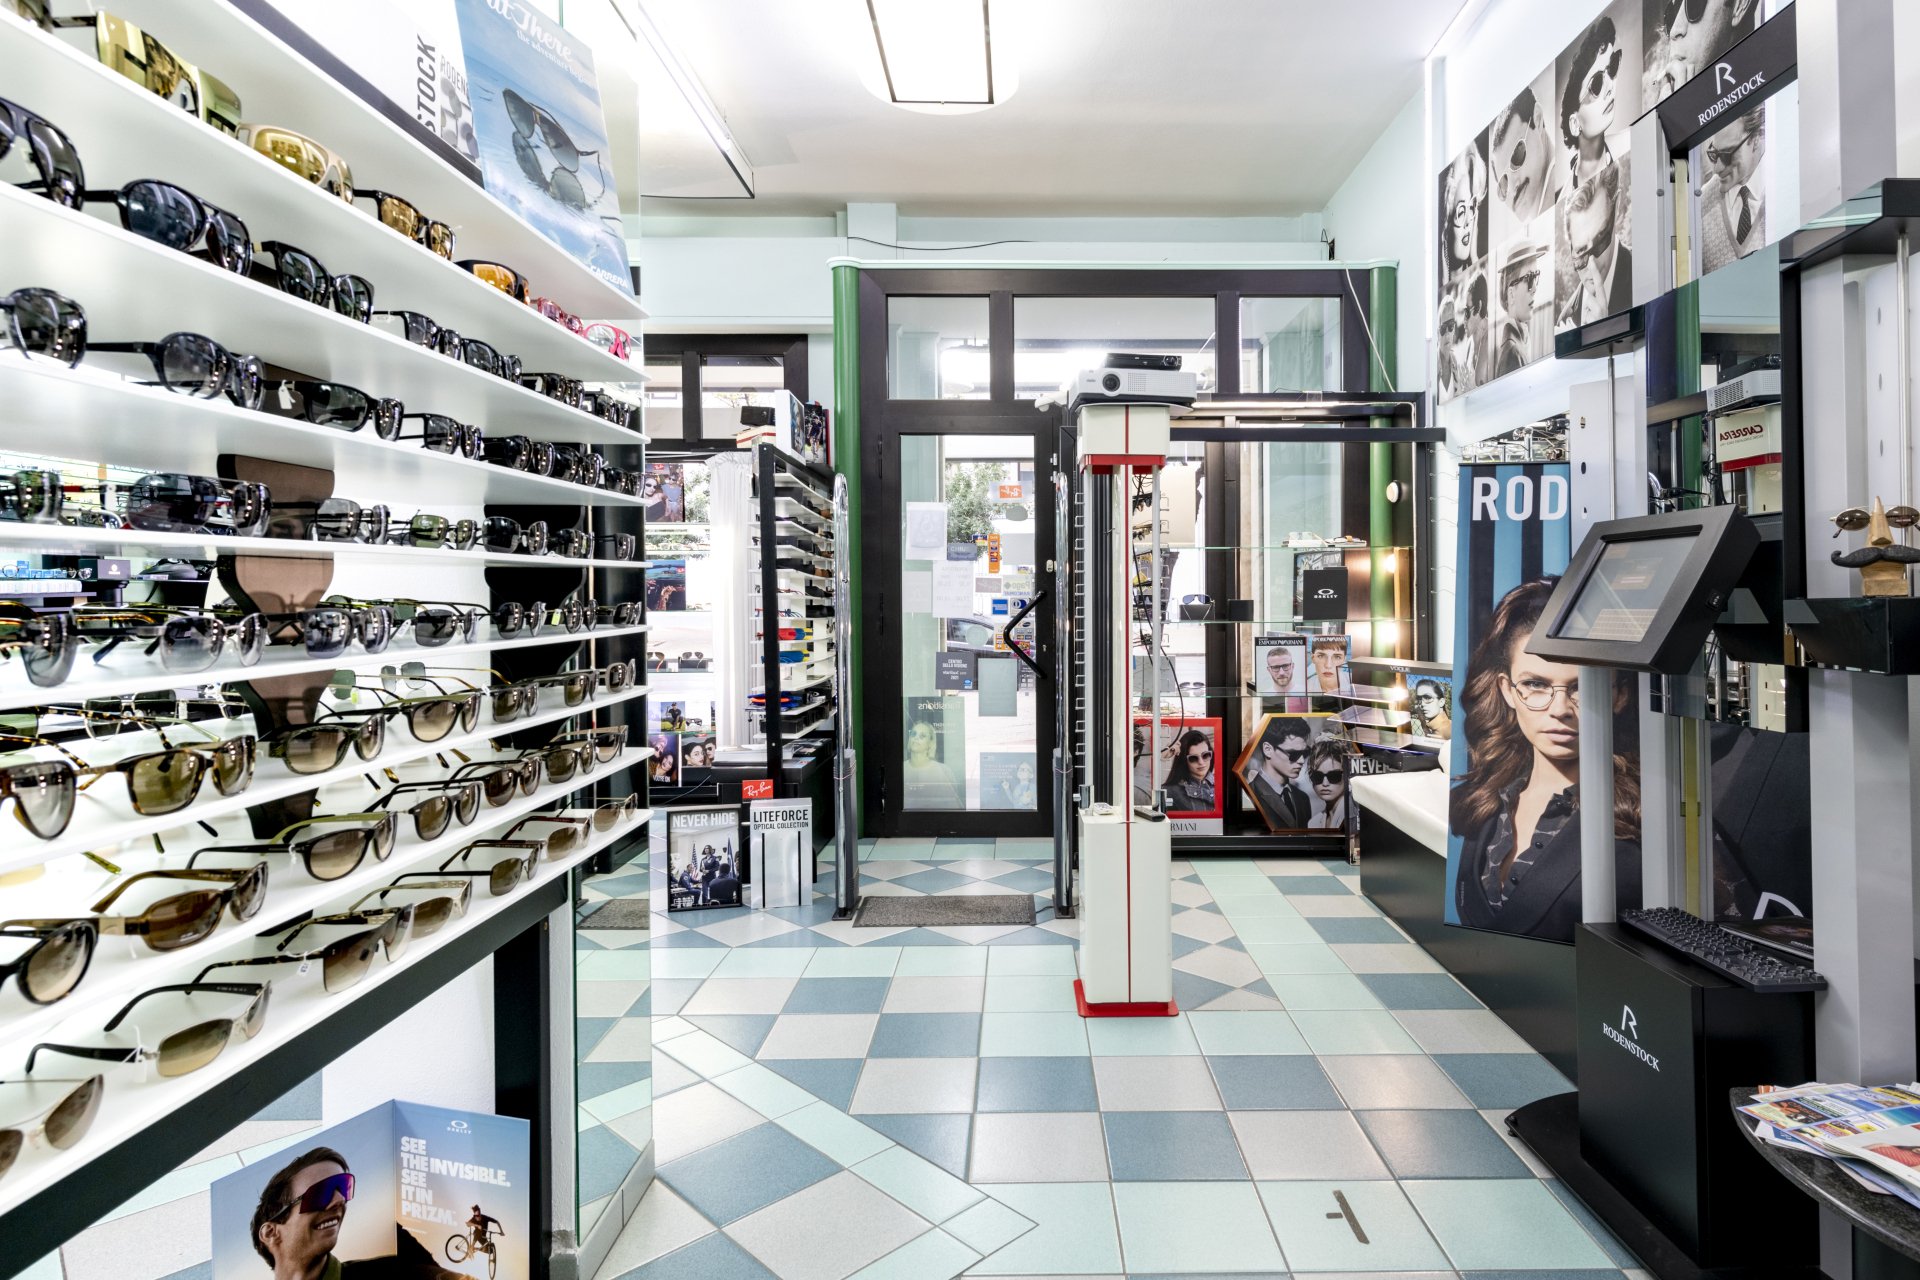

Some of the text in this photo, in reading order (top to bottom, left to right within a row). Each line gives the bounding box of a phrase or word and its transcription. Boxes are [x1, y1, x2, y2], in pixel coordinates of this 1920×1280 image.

[511, 3, 573, 63] There
[516, 30, 530, 45] the
[1697, 71, 1766, 126] RODENSTOCK
[590, 265, 628, 289] CARRERA
[1472, 475, 1568, 522] ROD
[672, 812, 736, 828] NEVER HIDE
[753, 809, 809, 823] LITEFORCE
[753, 821, 809, 830] OPTICAL COLLECTION
[1602, 1022, 1660, 1072] RODENSTOCK
[447, 1126, 472, 1135] OAKLEY
[400, 1136, 427, 1155] SEE
[400, 1152, 511, 1187] THE INVISIBLE.
[401, 1168, 427, 1187] SEE
[402, 1184, 433, 1205] IT IN
